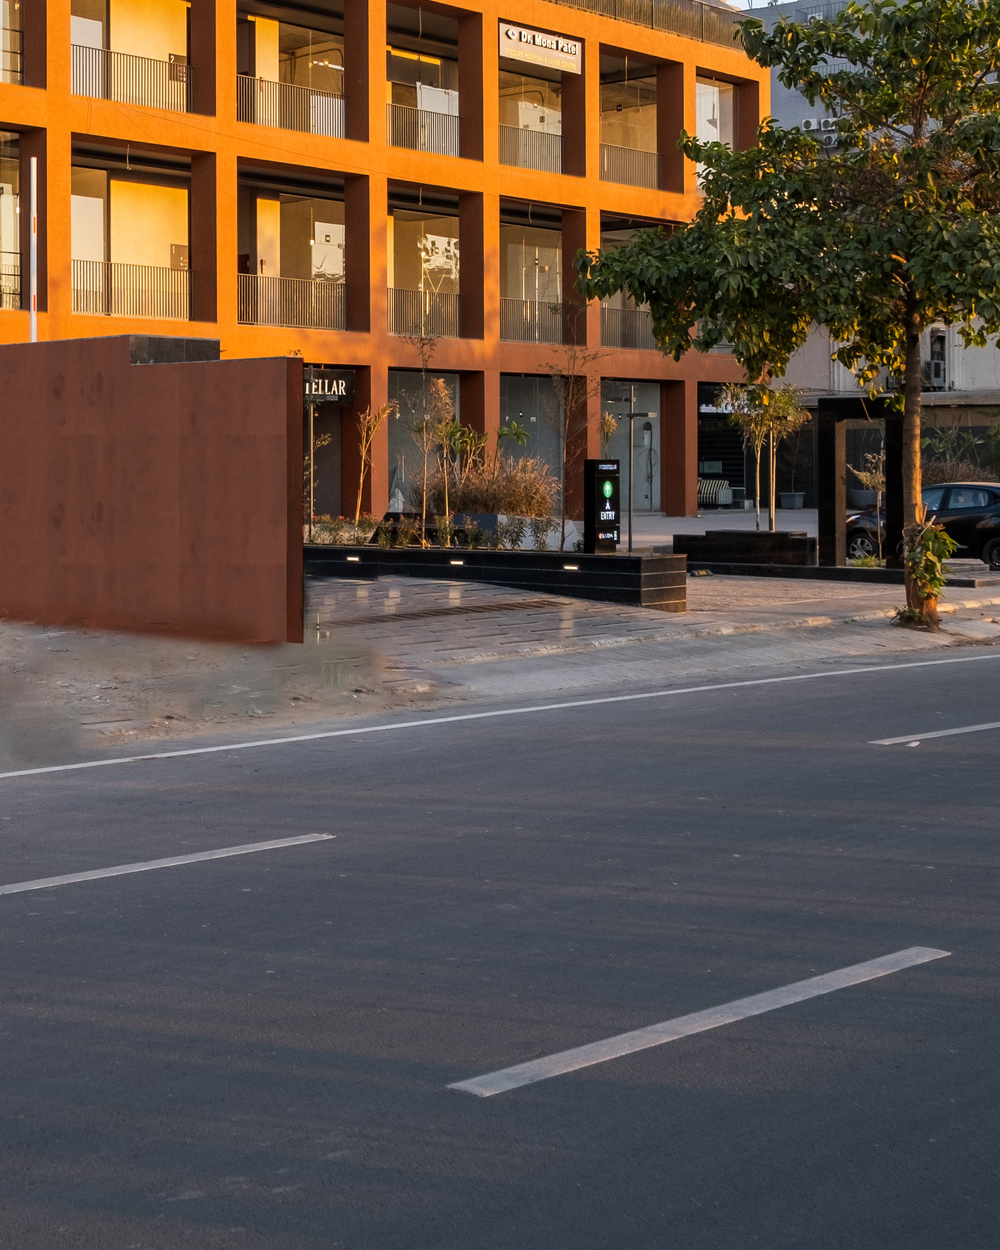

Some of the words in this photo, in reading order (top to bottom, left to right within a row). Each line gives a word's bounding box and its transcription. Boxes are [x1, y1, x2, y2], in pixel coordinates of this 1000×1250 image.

[520, 31, 533, 44] Dr.
[534, 35, 556, 50] Mona
[558, 40, 579, 55] Patel
[600, 511, 615, 520] ENTRY
